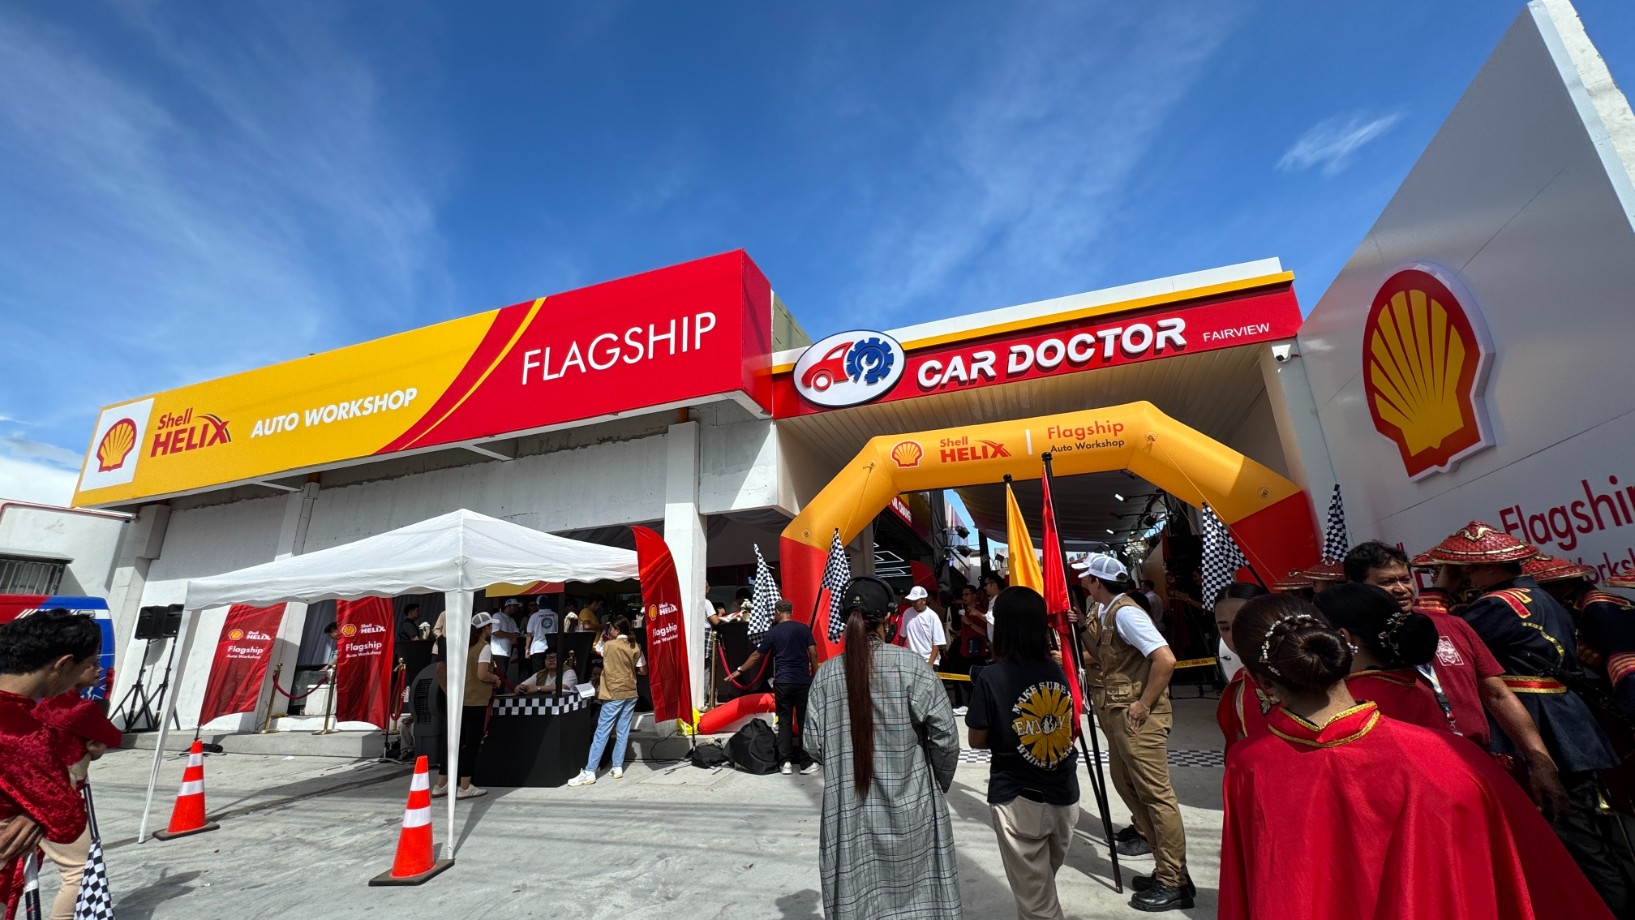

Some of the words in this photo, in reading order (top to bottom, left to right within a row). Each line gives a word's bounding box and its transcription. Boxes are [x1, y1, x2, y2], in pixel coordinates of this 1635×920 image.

[1202, 322, 1271, 342] FAIRVIEW
[521, 311, 717, 385] FLAGSHIP
[917, 350, 997, 389] CAR
[1006, 317, 1187, 374] DOCTOR
[157, 407, 194, 430] Shell
[250, 412, 299, 438] AUTO
[304, 388, 418, 428] WORKSHOP
[150, 413, 232, 458] HELIX
[1047, 420, 1125, 441] Flagship
[939, 436, 969, 448] Shell
[940, 440, 1012, 463] HELIX
[1050, 444, 1073, 454] Auto
[1074, 438, 1125, 451] Workshop
[361, 625, 386, 634] HELIX
[227, 645, 264, 655] Flagship
[345, 641, 382, 651] Flagship
[1012, 684, 1038, 715] MAKE
[1038, 681, 1067, 694] SURE
